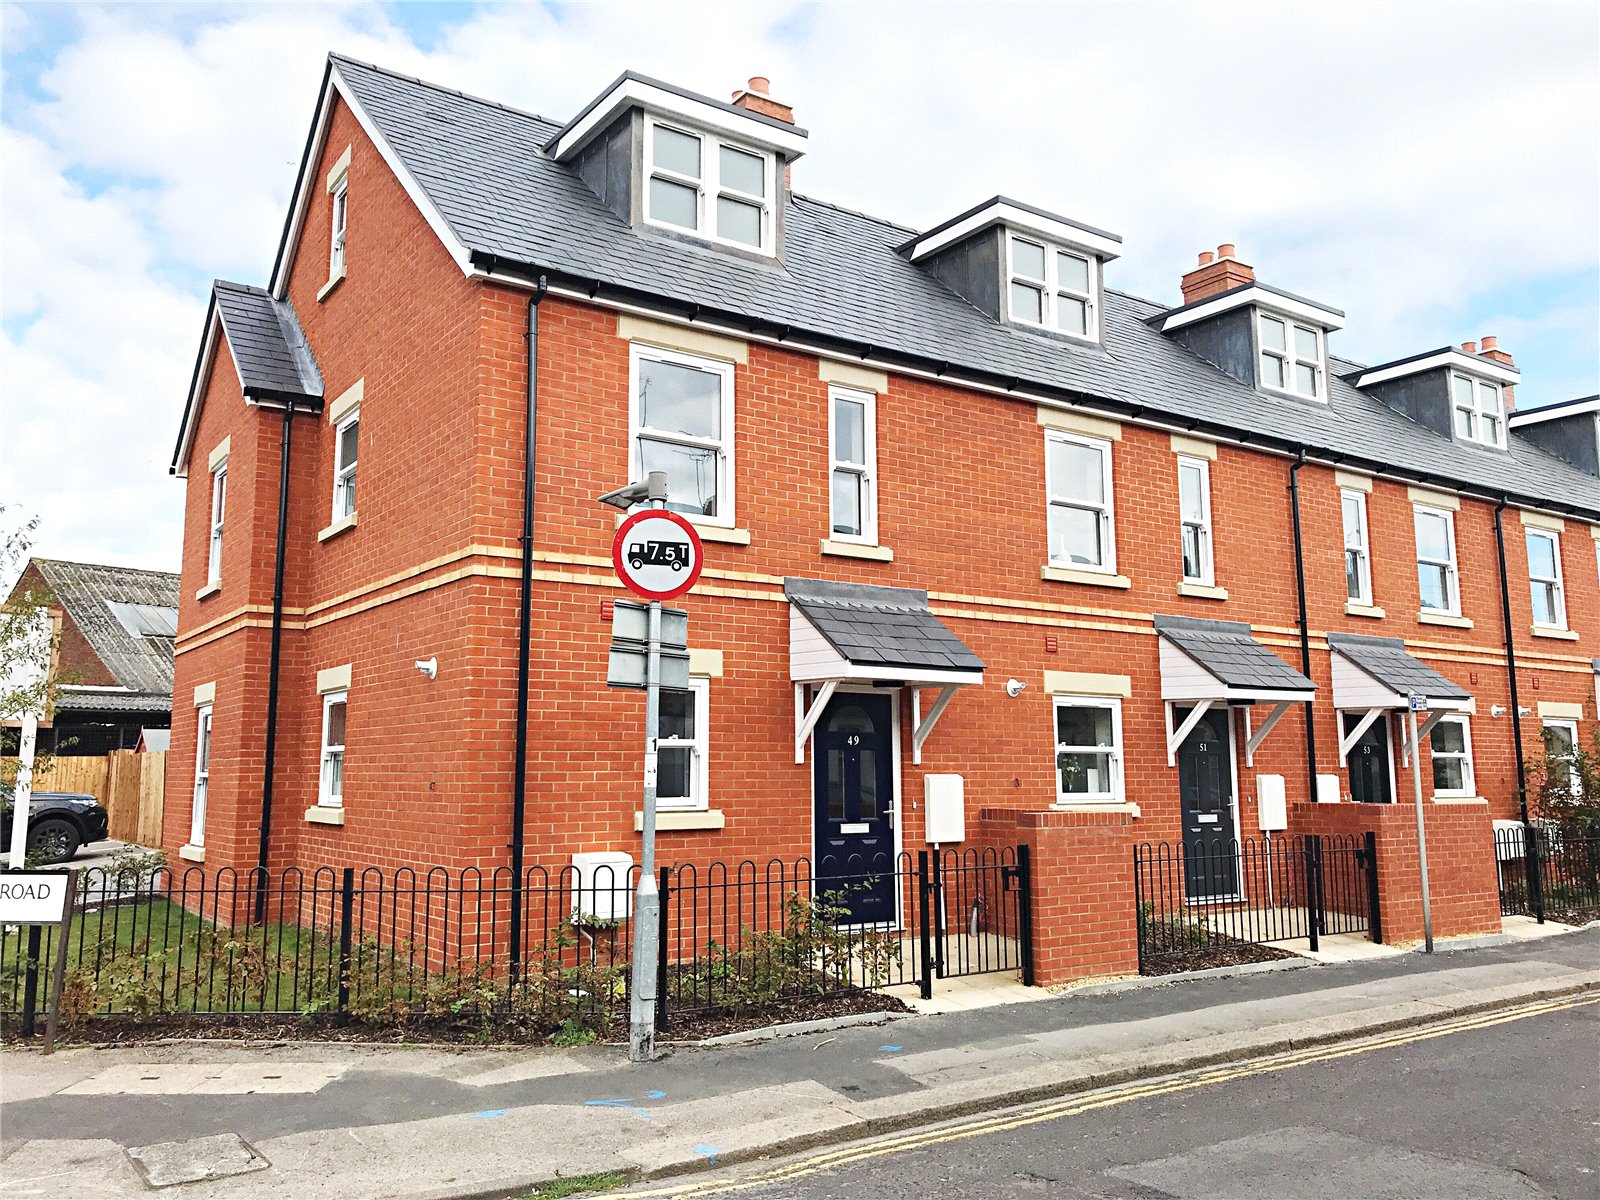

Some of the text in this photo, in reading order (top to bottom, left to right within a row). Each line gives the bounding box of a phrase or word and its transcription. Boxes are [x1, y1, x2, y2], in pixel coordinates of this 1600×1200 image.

[847, 735, 860, 746] 49
[1199, 743, 1208, 752] 51
[1363, 746, 1371, 754] 53
[0, 884, 51, 900] ROAD
